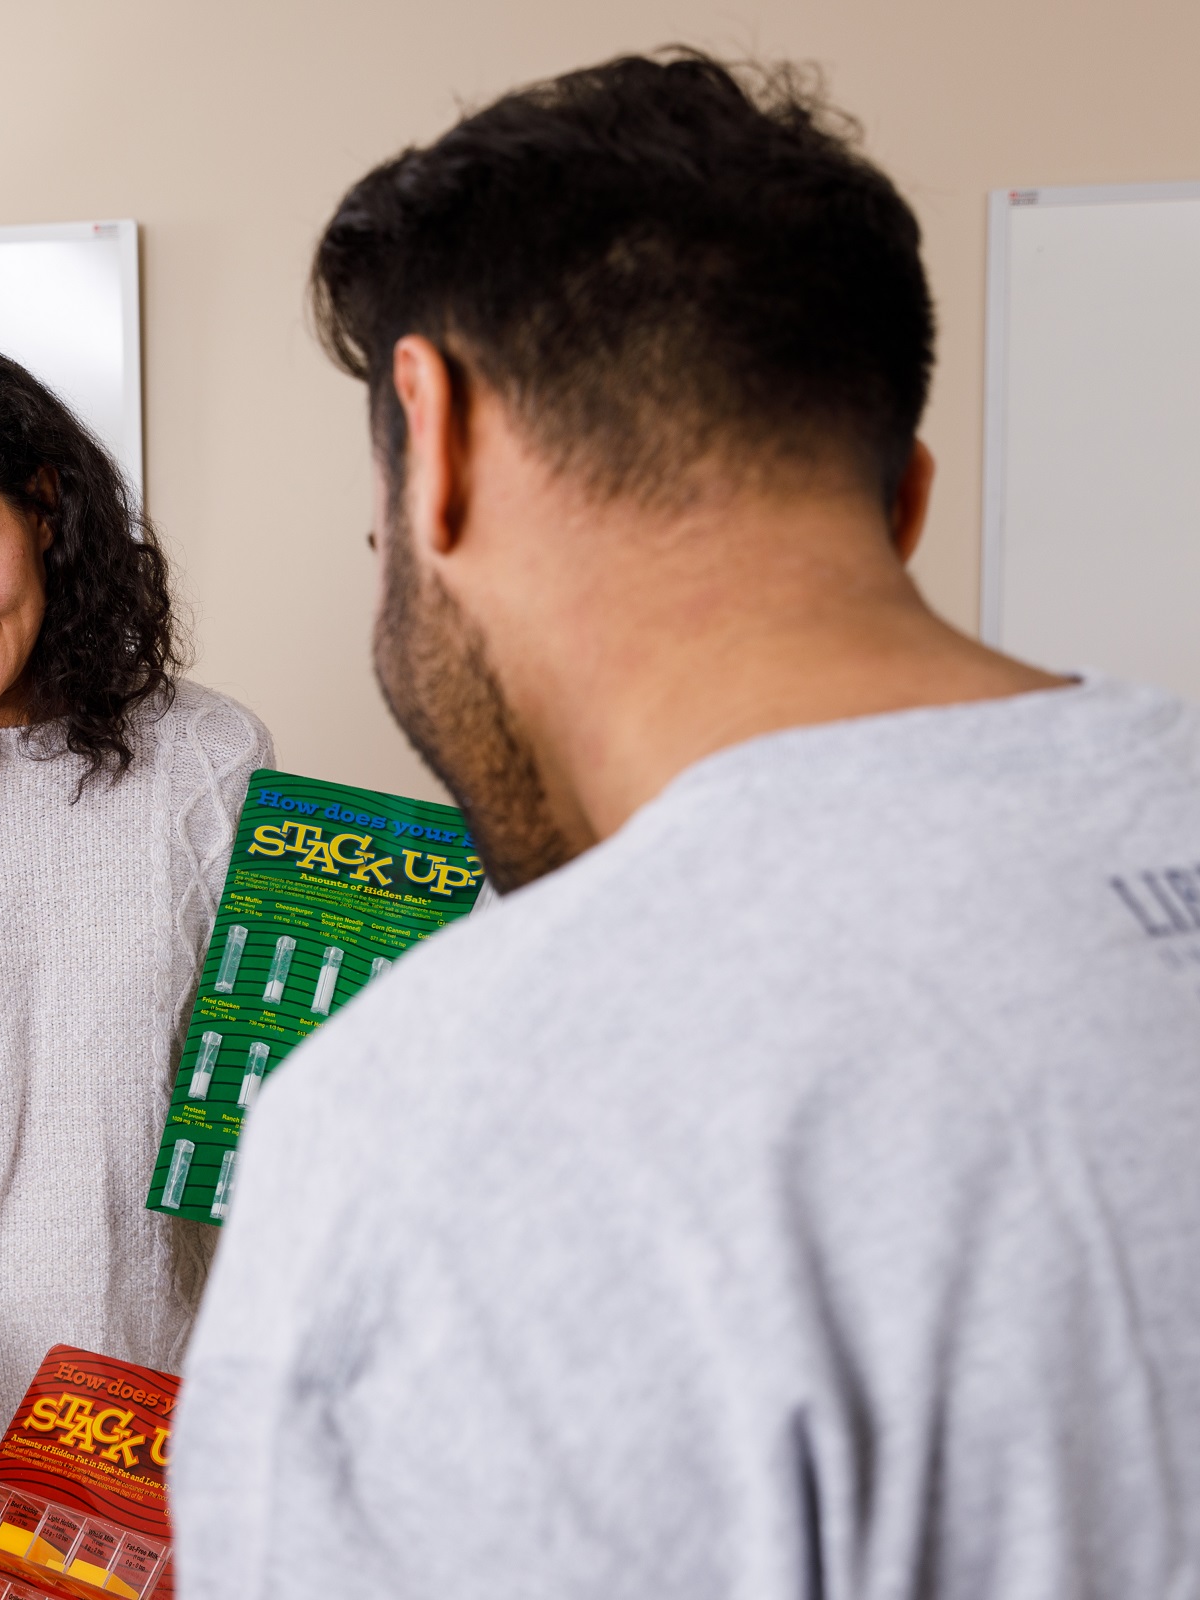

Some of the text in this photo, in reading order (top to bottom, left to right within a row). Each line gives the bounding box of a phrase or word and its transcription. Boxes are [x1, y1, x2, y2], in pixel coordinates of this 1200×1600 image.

[257, 788, 320, 816] How
[324, 802, 386, 830] does
[392, 818, 458, 845] your
[248, 820, 394, 887] STACK
[300, 873, 348, 889] Amounts
[350, 884, 363, 892] of
[363, 886, 402, 901] Hidden
[276, 903, 314, 916] Cheeseburger
[321, 912, 364, 927] Chicken Noodle
[321, 920, 336, 928] Soup
[202, 997, 216, 1005] Fried
[218, 1000, 240, 1010] Chicken
[263, 1010, 276, 1018] Ham
[184, 1105, 206, 1115] Pretzels
[222, 1114, 240, 1123] Ranch
[54, 1362, 106, 1390] How
[107, 1378, 161, 1408] does
[21, 1392, 146, 1469] STACK
[11, 1434, 42, 1450] Amounts
[42, 1444, 51, 1452] of
[50, 1447, 75, 1461] Hidden
[75, 1454, 88, 1464] Fat
[97, 1462, 130, 1479] High-Fat
[131, 1475, 145, 1484] and
[11, 1501, 40, 1516] Beef Hotdog
[48, 1514, 61, 1524] Light
[104, 1534, 114, 1544] Milk
[126, 1544, 159, 1560] Fat-Free Milk
